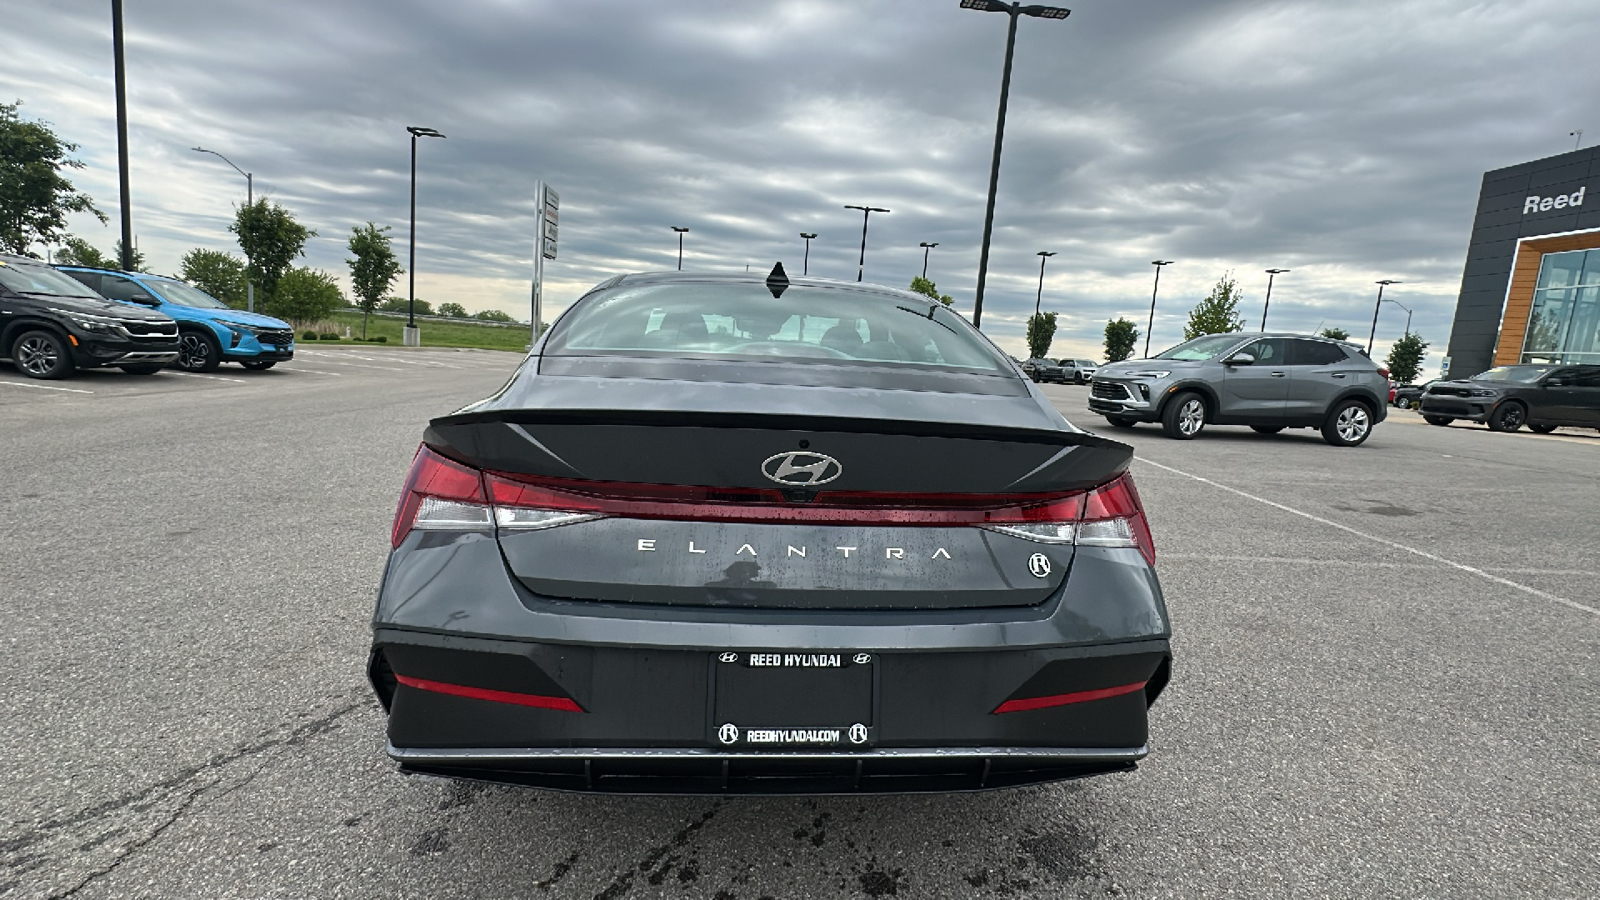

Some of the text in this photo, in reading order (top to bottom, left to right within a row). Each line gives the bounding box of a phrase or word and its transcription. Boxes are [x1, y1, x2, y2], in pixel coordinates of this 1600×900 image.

[1522, 186, 1586, 215] Reed
[637, 538, 951, 559] ELANTRA
[750, 653, 841, 667] REED HYUNDAI
[747, 729, 840, 743] REEDHYUNDAI.COM
